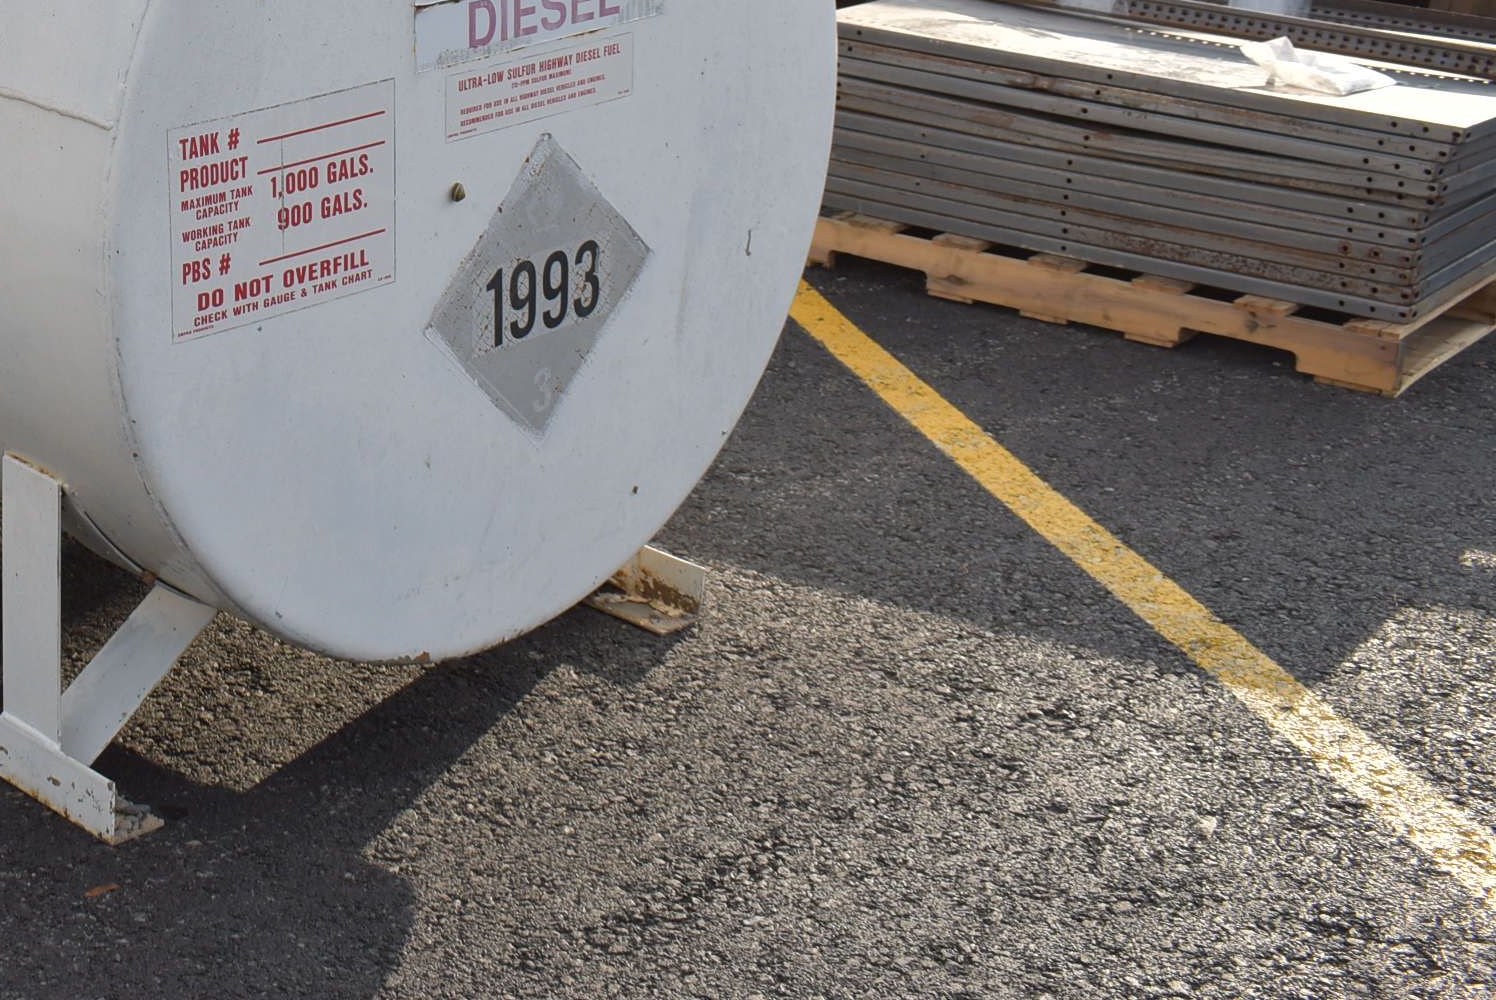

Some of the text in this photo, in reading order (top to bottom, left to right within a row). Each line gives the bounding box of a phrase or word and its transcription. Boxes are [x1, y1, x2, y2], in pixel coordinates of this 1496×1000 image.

[459, 43, 621, 92] ULTRA-LOW SULFUR HIGHWAY DIESEL FUEL
[179, 127, 240, 160] TANK #
[180, 156, 248, 193] PRODUCT
[270, 153, 374, 199] 1,000 GALS.
[181, 185, 253, 212] MAXIMUM TANK
[196, 201, 239, 220] CAPACITY
[277, 188, 368, 231] 900 GALS.
[182, 217, 251, 243] WORKING TANK
[195, 232, 239, 251] CAPACITY
[182, 252, 231, 285] PBS #
[197, 248, 370, 312] DO NOT OVERFILL
[194, 309, 228, 327] CHECK
[233, 302, 259, 317] WITH
[263, 291, 296, 308] GAUGE
[300, 287, 308, 298] &
[313, 281, 338, 295] TANK
[342, 269, 373, 286] CHART
[486, 239, 600, 348] 1993
